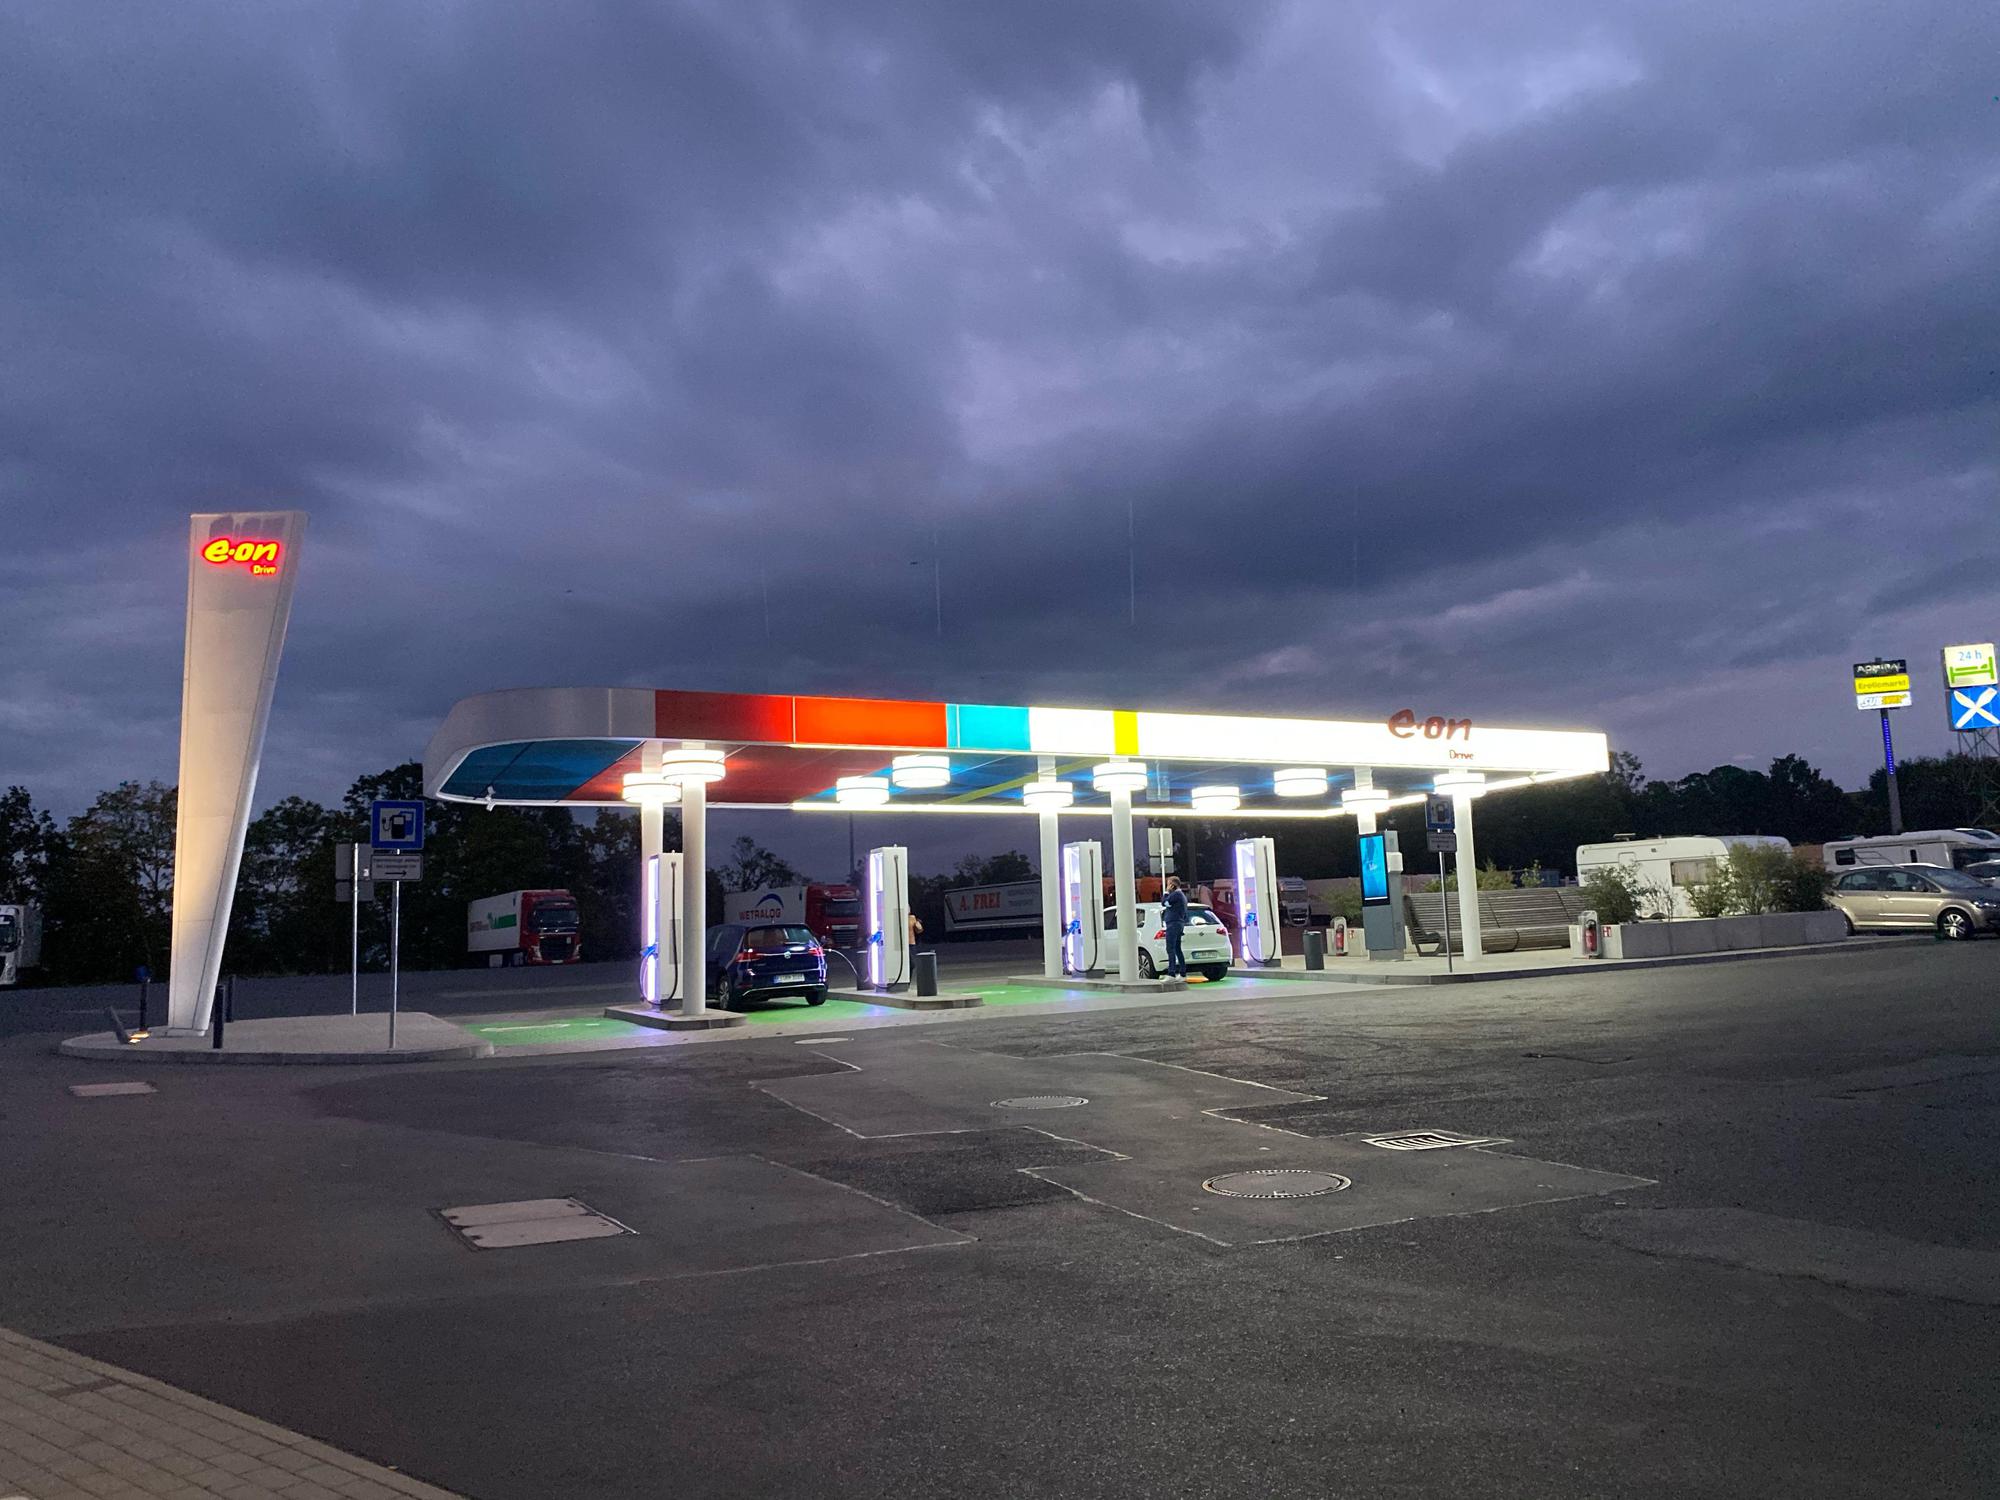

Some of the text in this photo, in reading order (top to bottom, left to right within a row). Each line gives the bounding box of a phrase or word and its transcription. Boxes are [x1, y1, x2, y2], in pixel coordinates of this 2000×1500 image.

[252, 564, 276, 575] Drive
[1958, 649, 1982, 662] 24 h
[1449, 749, 1474, 760] Drive
